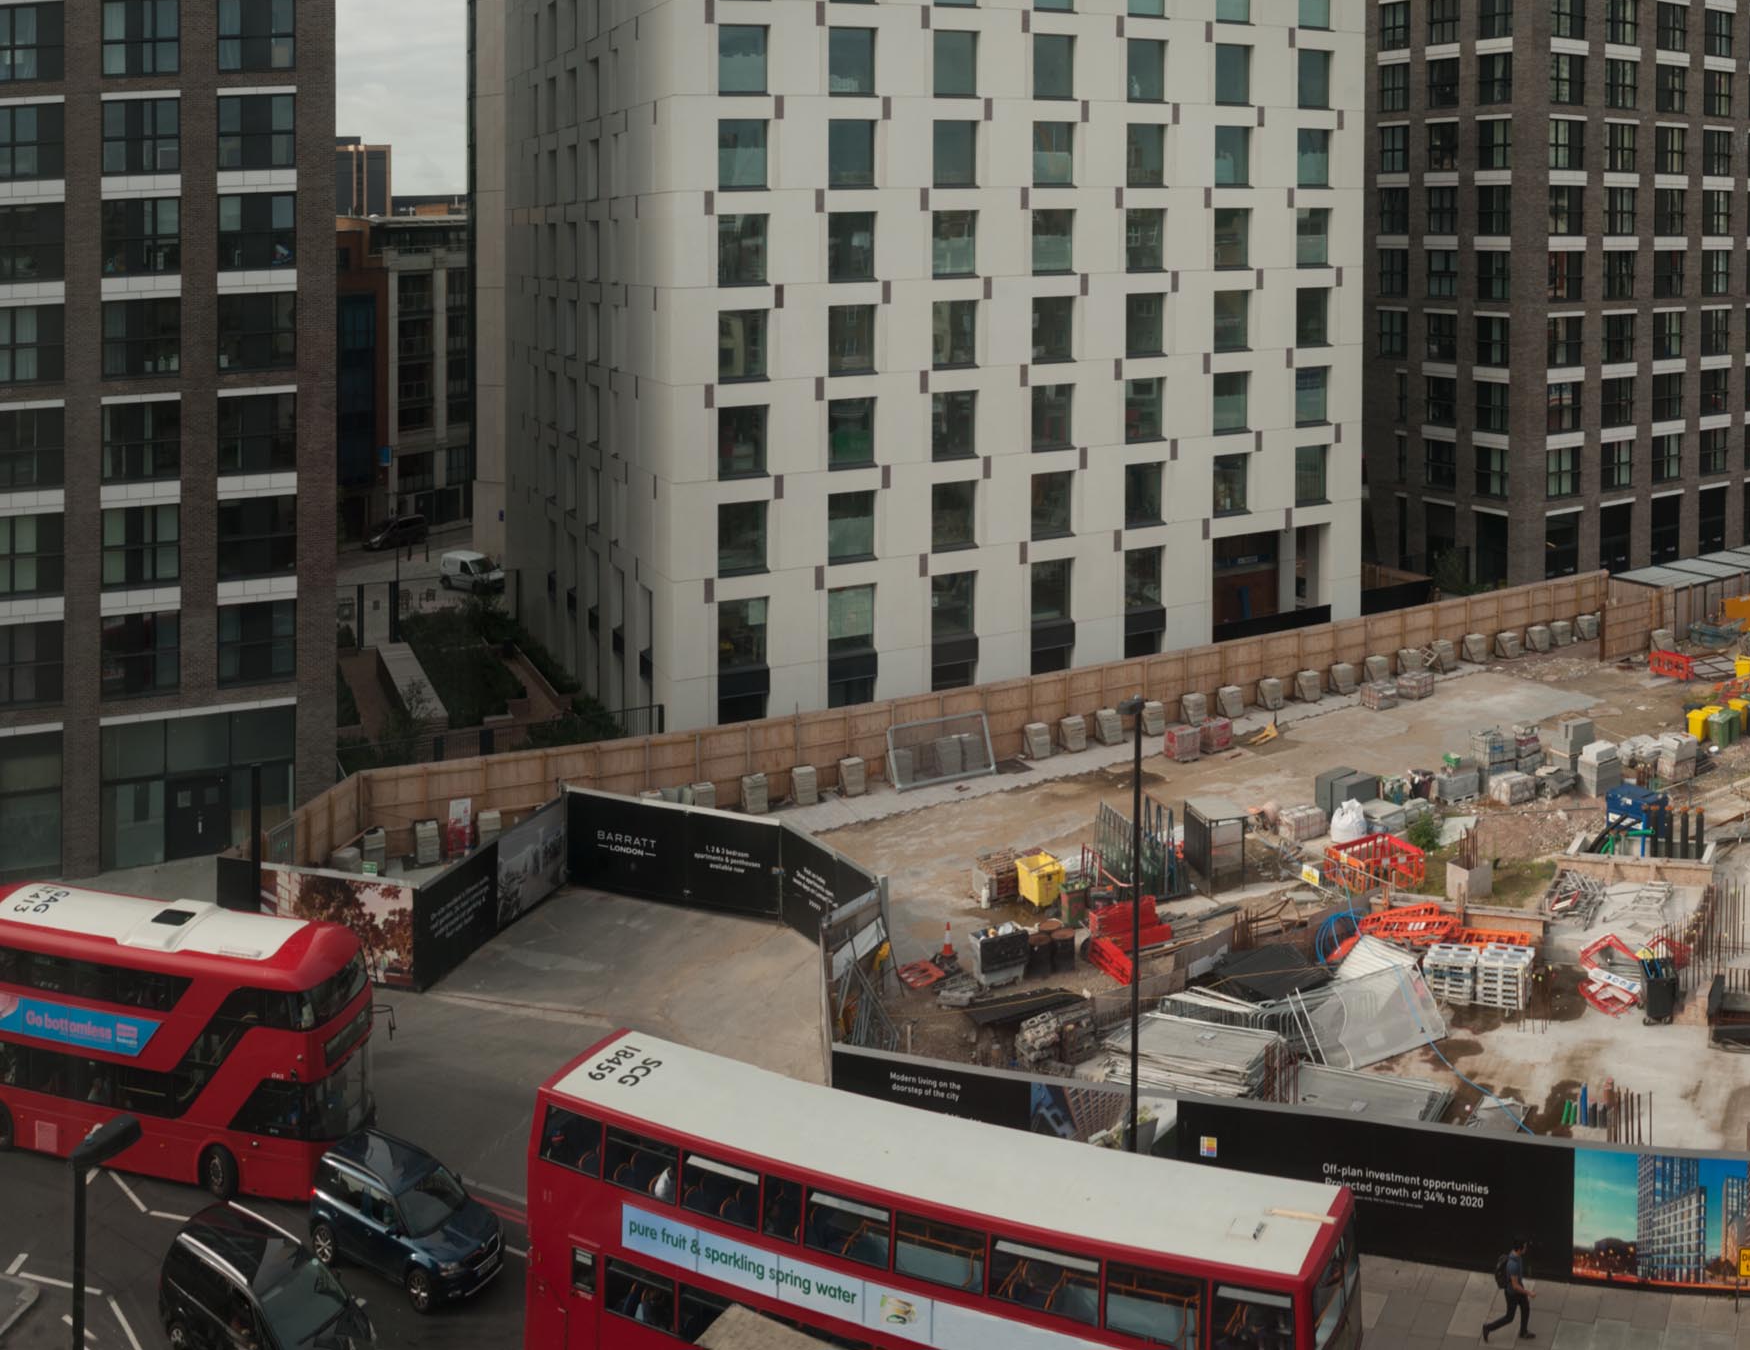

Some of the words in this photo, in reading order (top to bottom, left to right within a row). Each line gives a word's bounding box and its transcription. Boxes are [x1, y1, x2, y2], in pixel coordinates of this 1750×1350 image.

[597, 830, 656, 849] BARRATT
[609, 844, 644, 856] LONDON
[694, 852, 724, 863] apartments
[730, 857, 761, 869] penthouses
[725, 847, 749, 858] bedroom
[709, 862, 732, 872] available
[733, 866, 745, 874] now
[33, 891, 70, 914] GAG
[26, 1010, 43, 1027] Go
[44, 1012, 113, 1039] bottomless
[588, 1044, 642, 1081] 18459
[617, 1057, 663, 1087] SCG
[889, 1071, 917, 1084] Modern
[918, 1075, 937, 1089] living
[938, 1080, 948, 1088] on
[949, 1081, 962, 1091] the
[891, 1083, 923, 1097] doorstep
[924, 1088, 932, 1097] of
[933, 1088, 945, 1099] the
[946, 1092, 960, 1103] city
[1322, 1162, 1363, 1178] Off-plan
[1365, 1167, 1420, 1186] investment
[1423, 1177, 1489, 1195] opportunities
[1374, 1183, 1410, 1200] growth
[1411, 1188, 1422, 1200] of
[1423, 1189, 1446, 1204] 34%
[1447, 1194, 1457, 1205] to
[1460, 1194, 1484, 1209] 2020
[628, 1218, 659, 1241] pure
[660, 1230, 687, 1251] fruit
[690, 1238, 701, 1256] &
[704, 1243, 765, 1280] sparkling
[768, 1266, 812, 1294] spring
[815, 1279, 857, 1305] water
